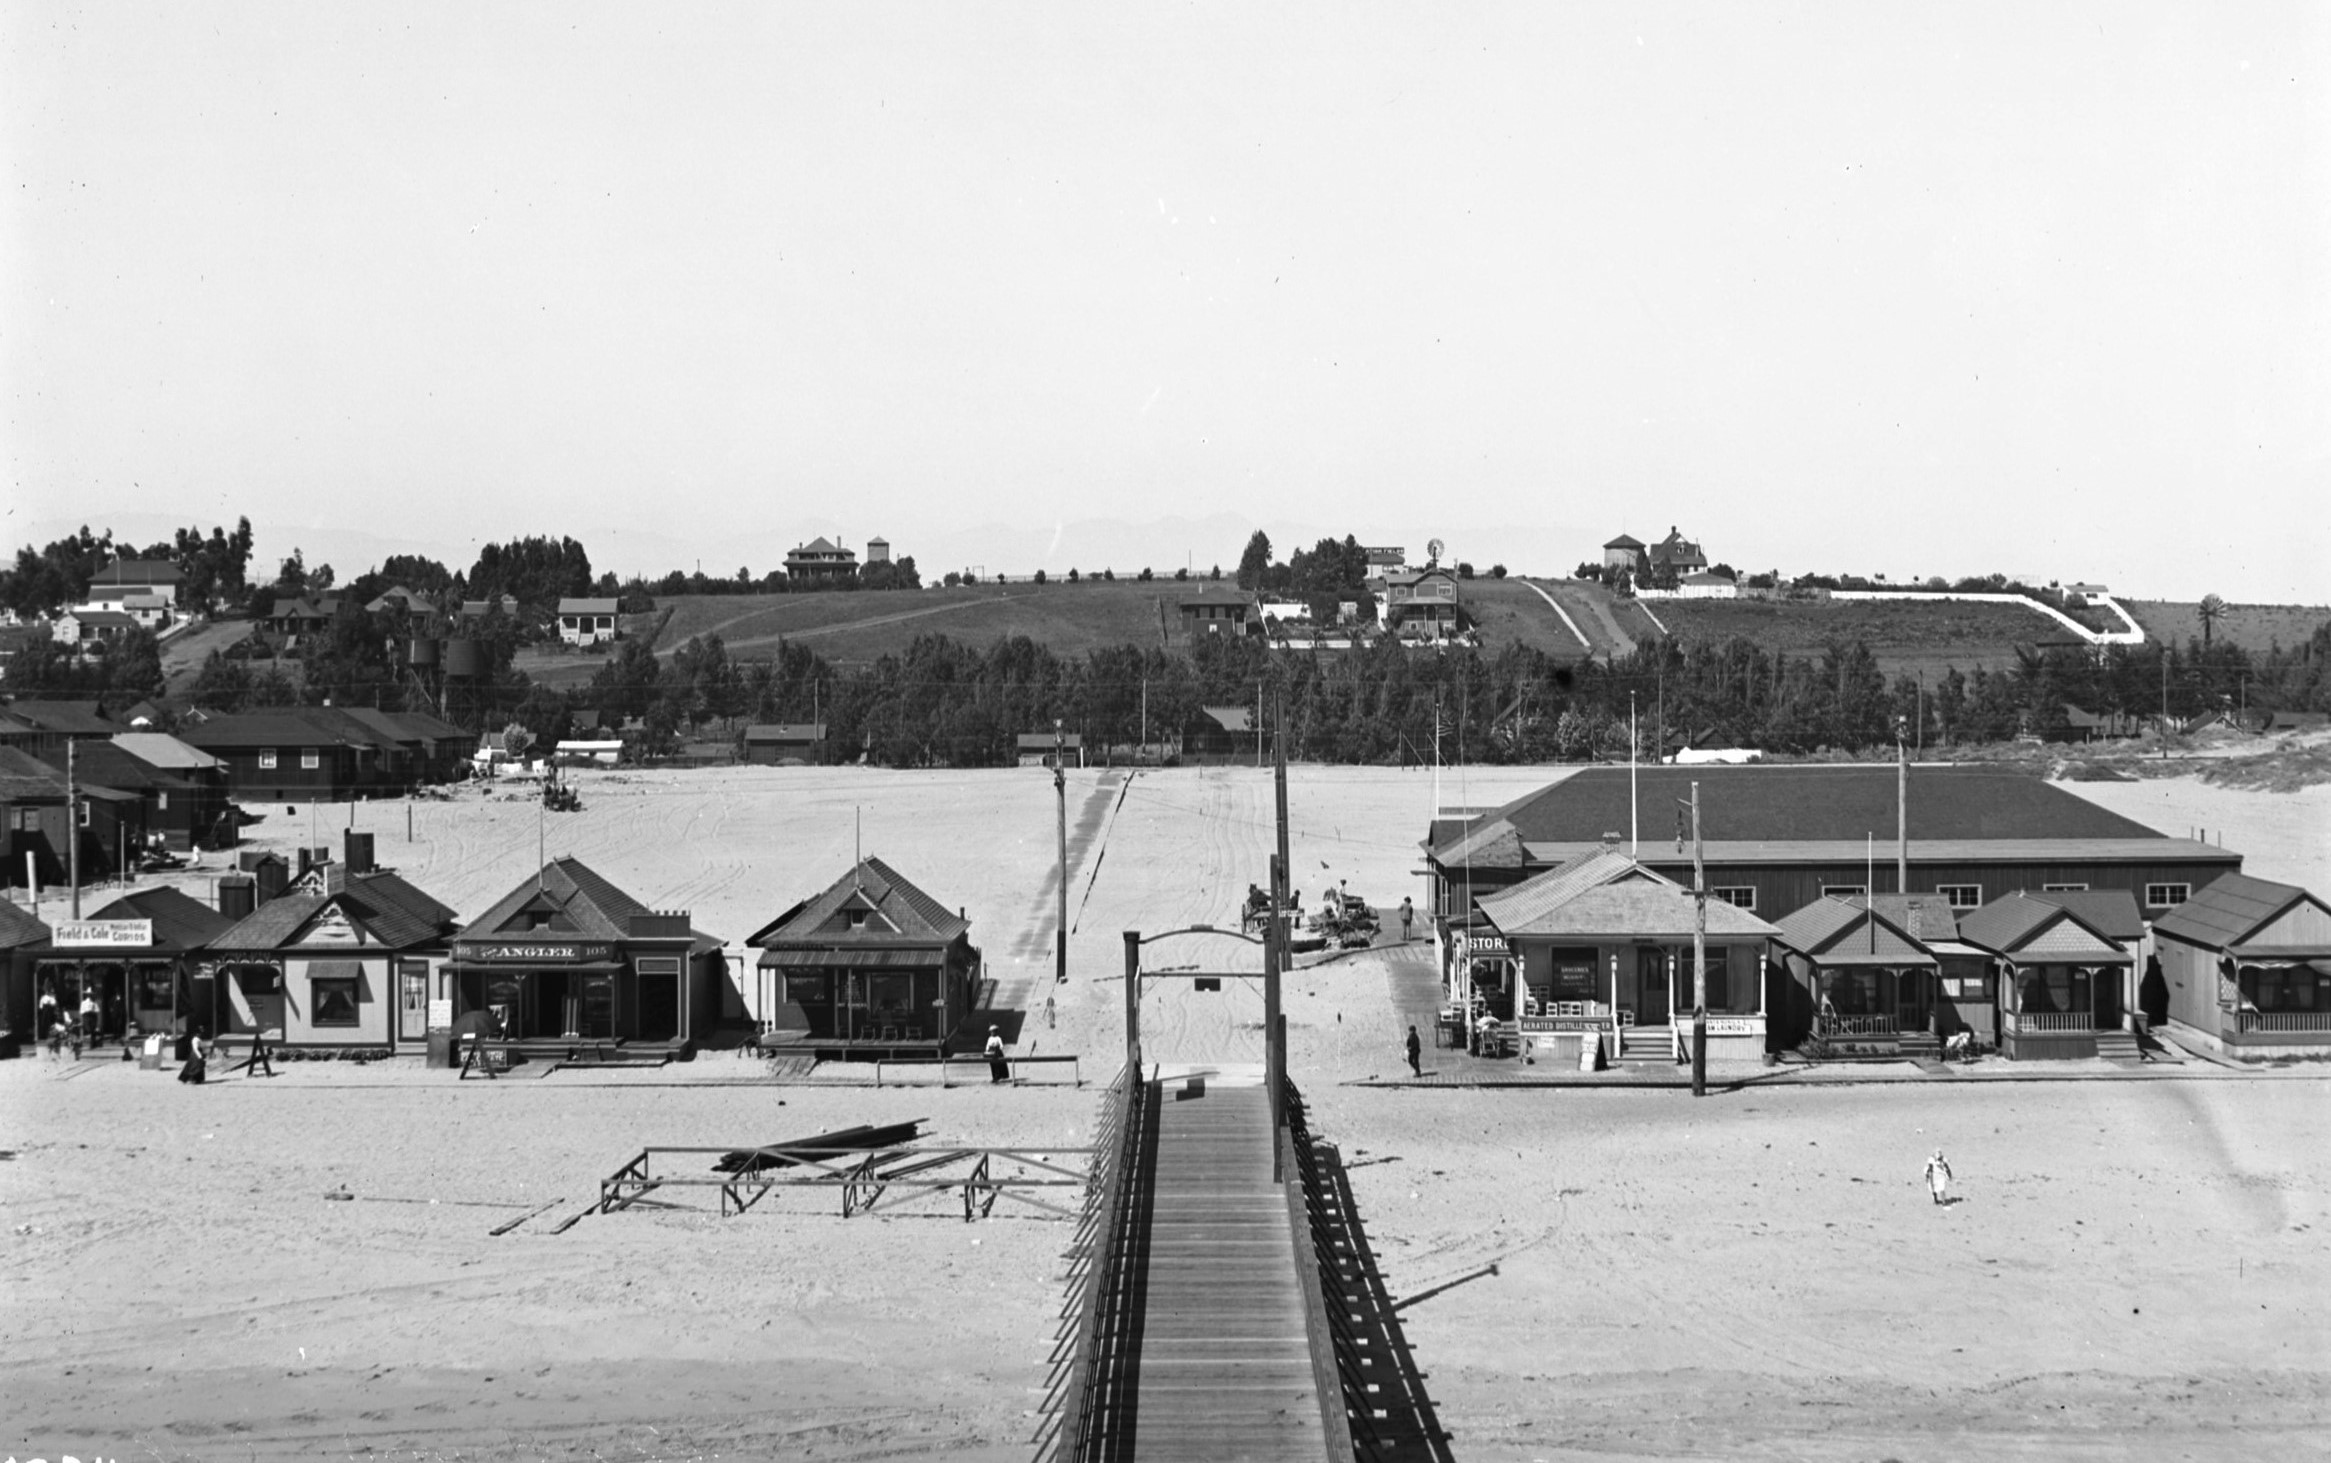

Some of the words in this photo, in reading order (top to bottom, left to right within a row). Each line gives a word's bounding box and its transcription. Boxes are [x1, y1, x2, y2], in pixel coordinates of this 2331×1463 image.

[57, 927, 82, 940] Field
[496, 947, 575, 958] ANGLER
[586, 946, 607, 956] 105
[1523, 1021, 1554, 1030] AERATED
[1555, 1021, 1584, 1030] DISTILLE
